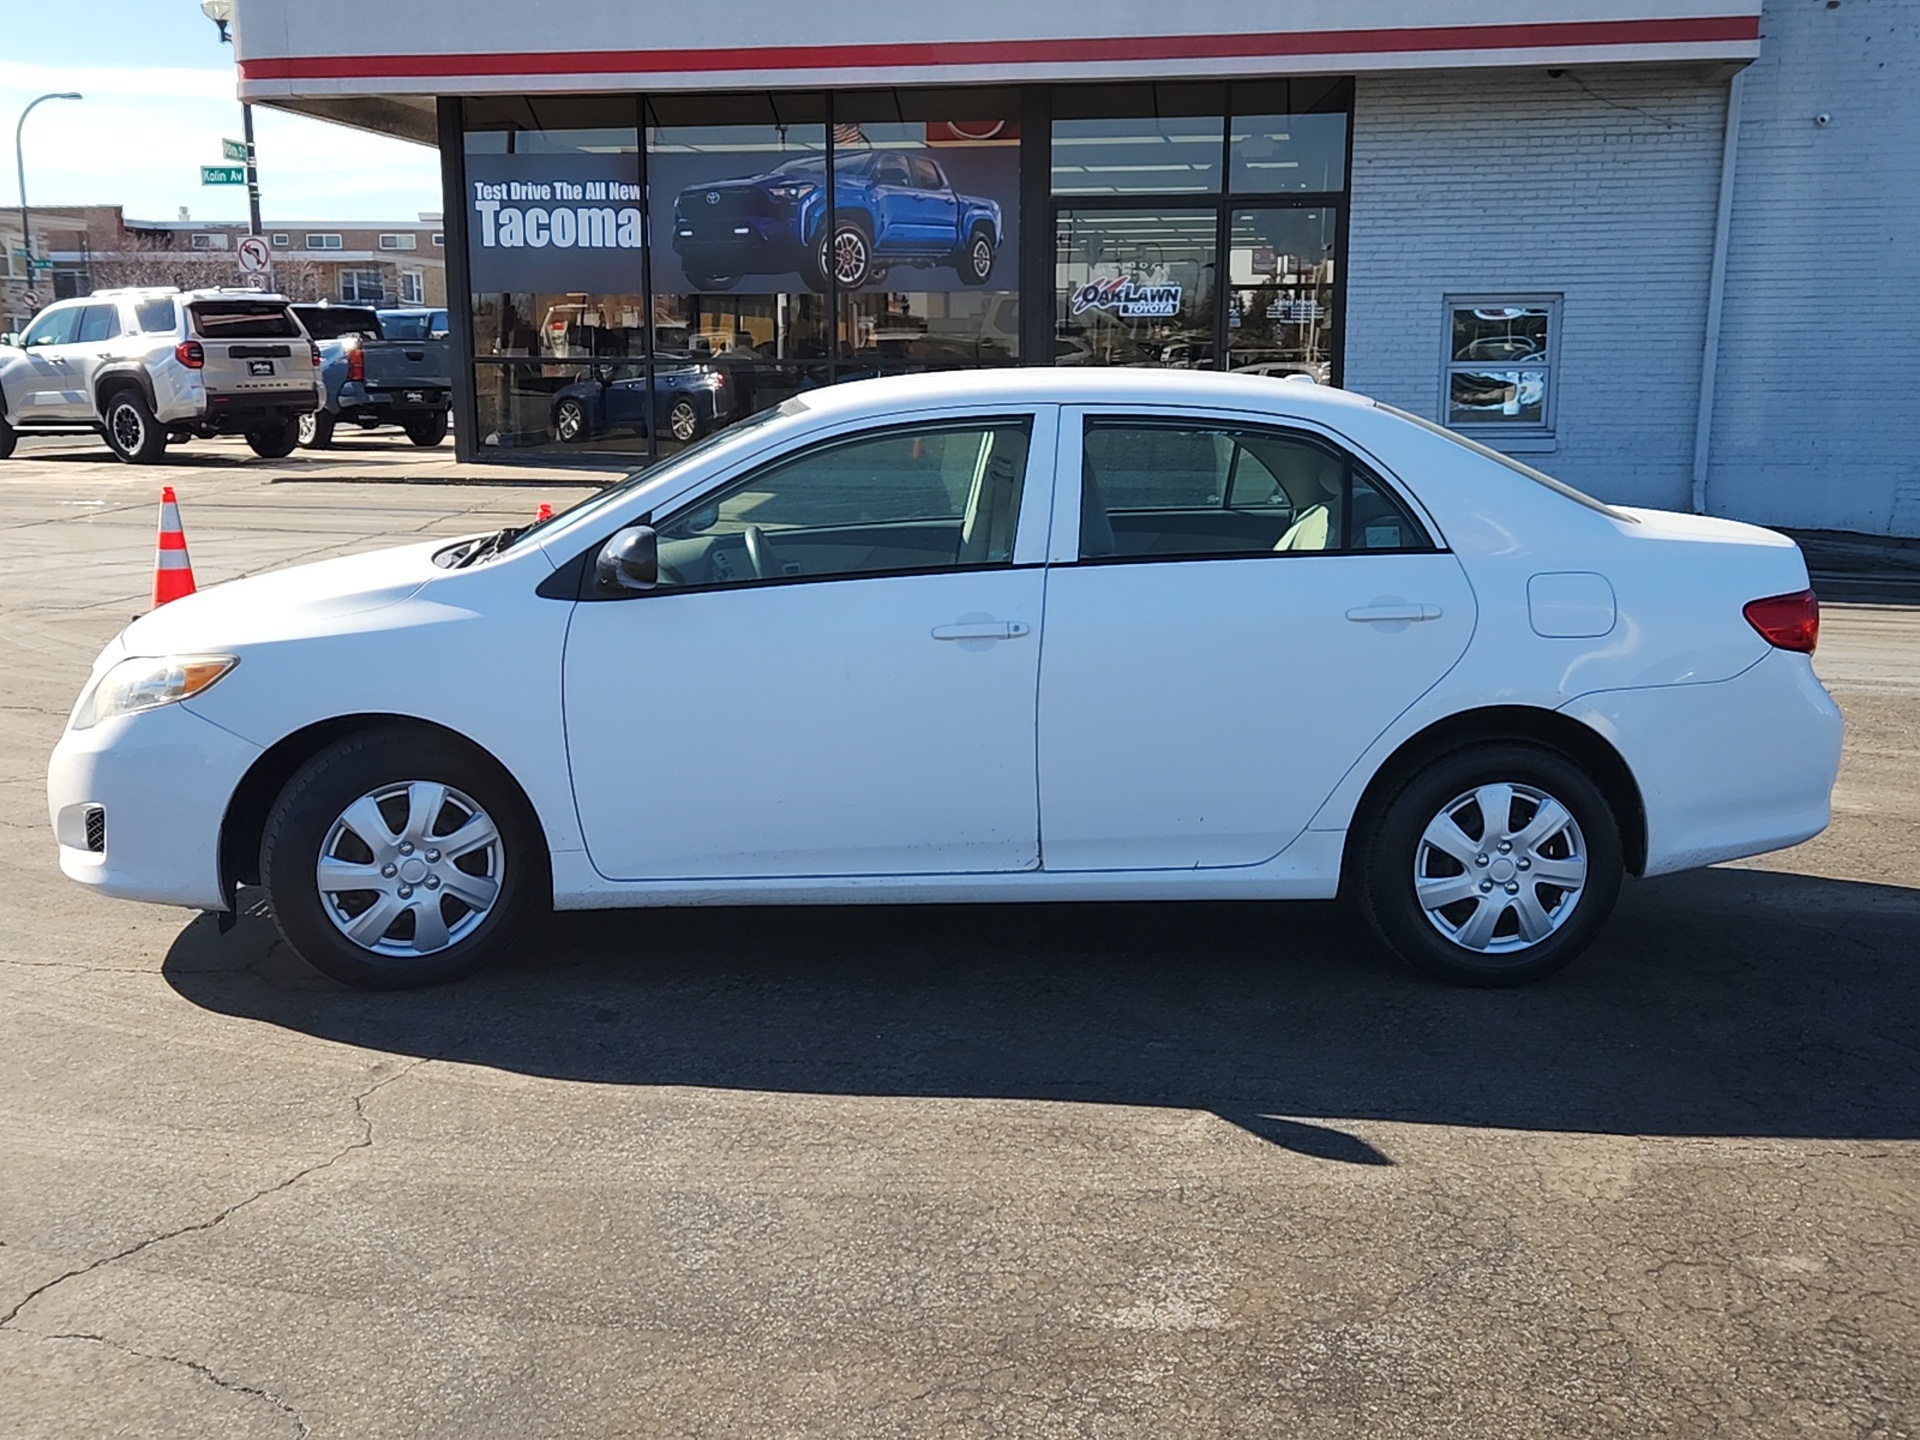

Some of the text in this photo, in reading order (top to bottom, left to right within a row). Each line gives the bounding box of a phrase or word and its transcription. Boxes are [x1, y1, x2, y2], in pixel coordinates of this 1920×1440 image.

[203, 169, 242, 181] Kolin Av
[474, 181, 641, 200] Test Drive The All New
[475, 200, 642, 248] Tacoma
[1127, 303, 1174, 314] TOYOTA
